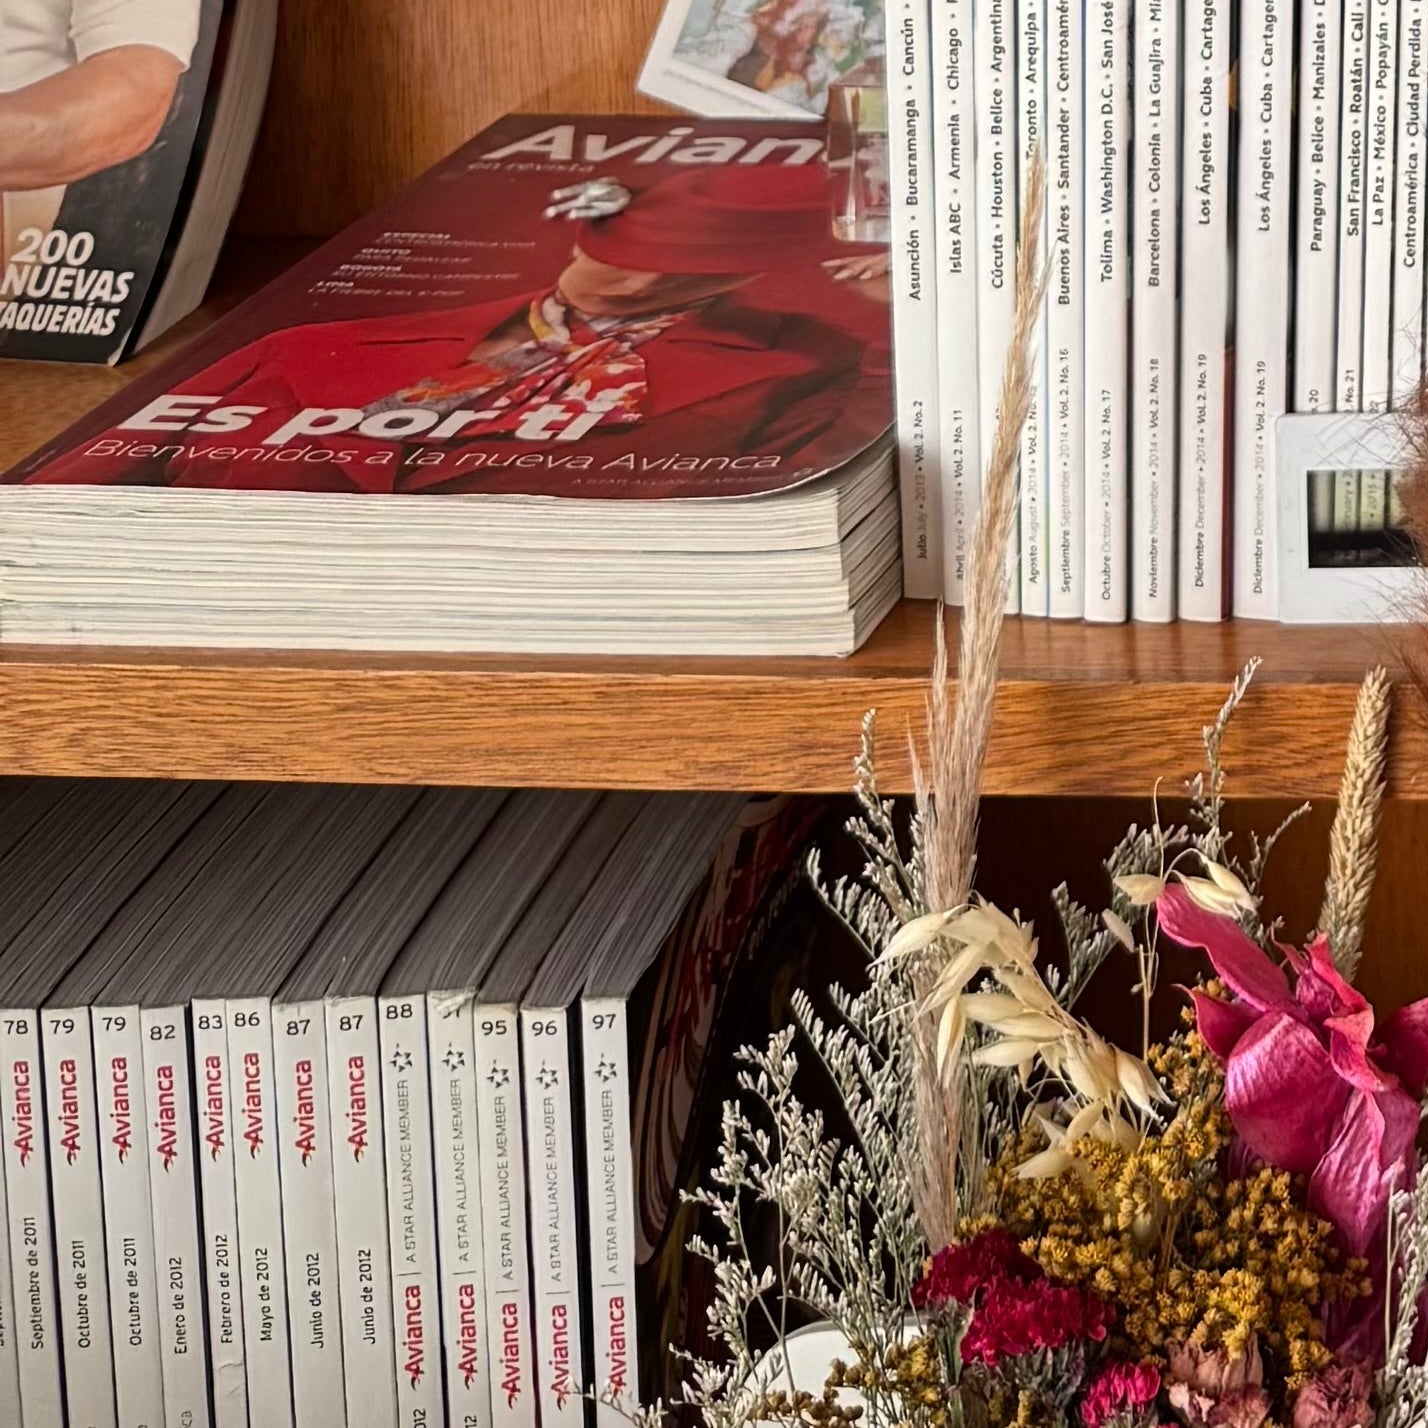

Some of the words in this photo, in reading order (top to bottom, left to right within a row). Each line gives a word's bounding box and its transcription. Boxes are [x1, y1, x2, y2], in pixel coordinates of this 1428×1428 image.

[901, 17, 915, 76] Cancún
[1200, 73, 1213, 118] Cuba
[905, 98, 920, 207] Bucaramanga
[1057, 105, 1071, 190] Santander
[1198, 132, 1214, 195] Ángeles
[1199, 197, 1211, 225] Los
[10, 227, 95, 266] 200
[908, 228, 922, 302] Asunción
[1, 265, 135, 305] NUEVAS
[117, 395, 268, 433] Es
[262, 406, 496, 445] por
[84, 439, 359, 465] Bienvenidos
[364, 451, 394, 465] a
[405, 448, 446, 466] la
[456, 451, 594, 470] nueva
[602, 451, 782, 472] Avianca
[49, 1019, 75, 1035] 79
[234, 1011, 261, 1027] 86
[531, 1020, 558, 1036] 96
[58, 1059, 81, 1151] Avianca
[73, 1239, 86, 1269] 2011
[77, 1271, 88, 1291] de
[78, 1294, 91, 1349] Octubre
